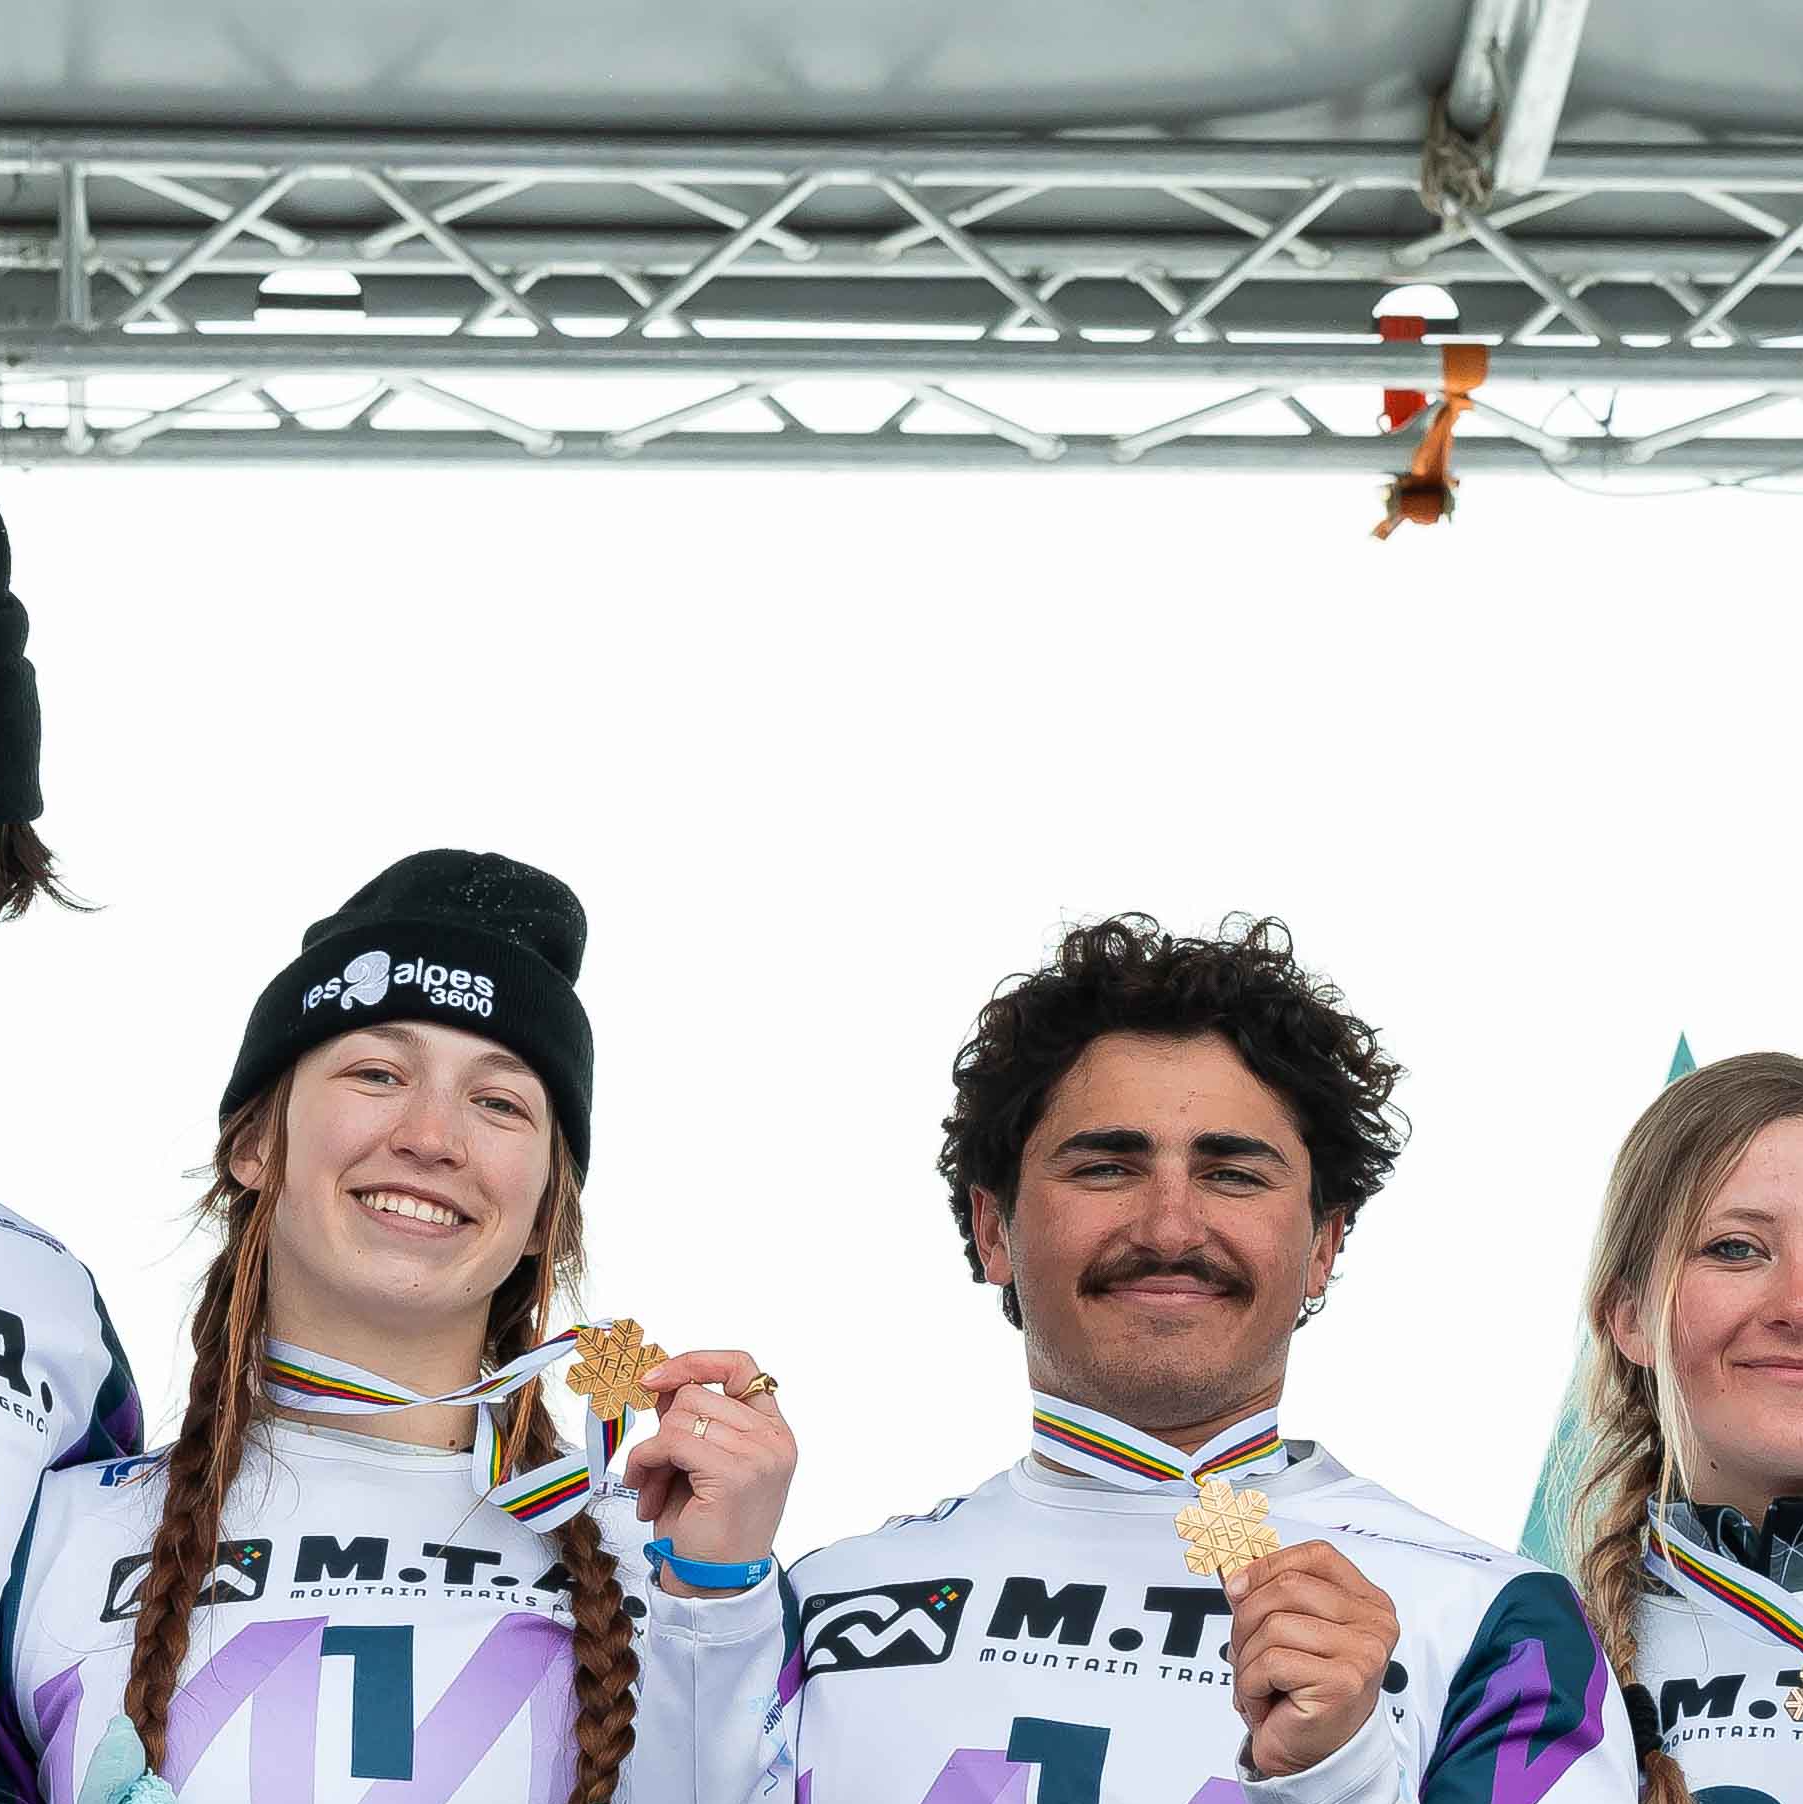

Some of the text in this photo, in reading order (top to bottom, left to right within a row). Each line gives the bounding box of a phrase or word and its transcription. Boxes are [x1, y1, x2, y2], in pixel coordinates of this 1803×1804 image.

[429, 988, 493, 1017] 3600
[290, 1585, 539, 1608] MOUNTAIN TRAILS
[978, 1647, 1233, 1686] MOUNTAIN TRAI
[321, 1624, 414, 1781] 1
